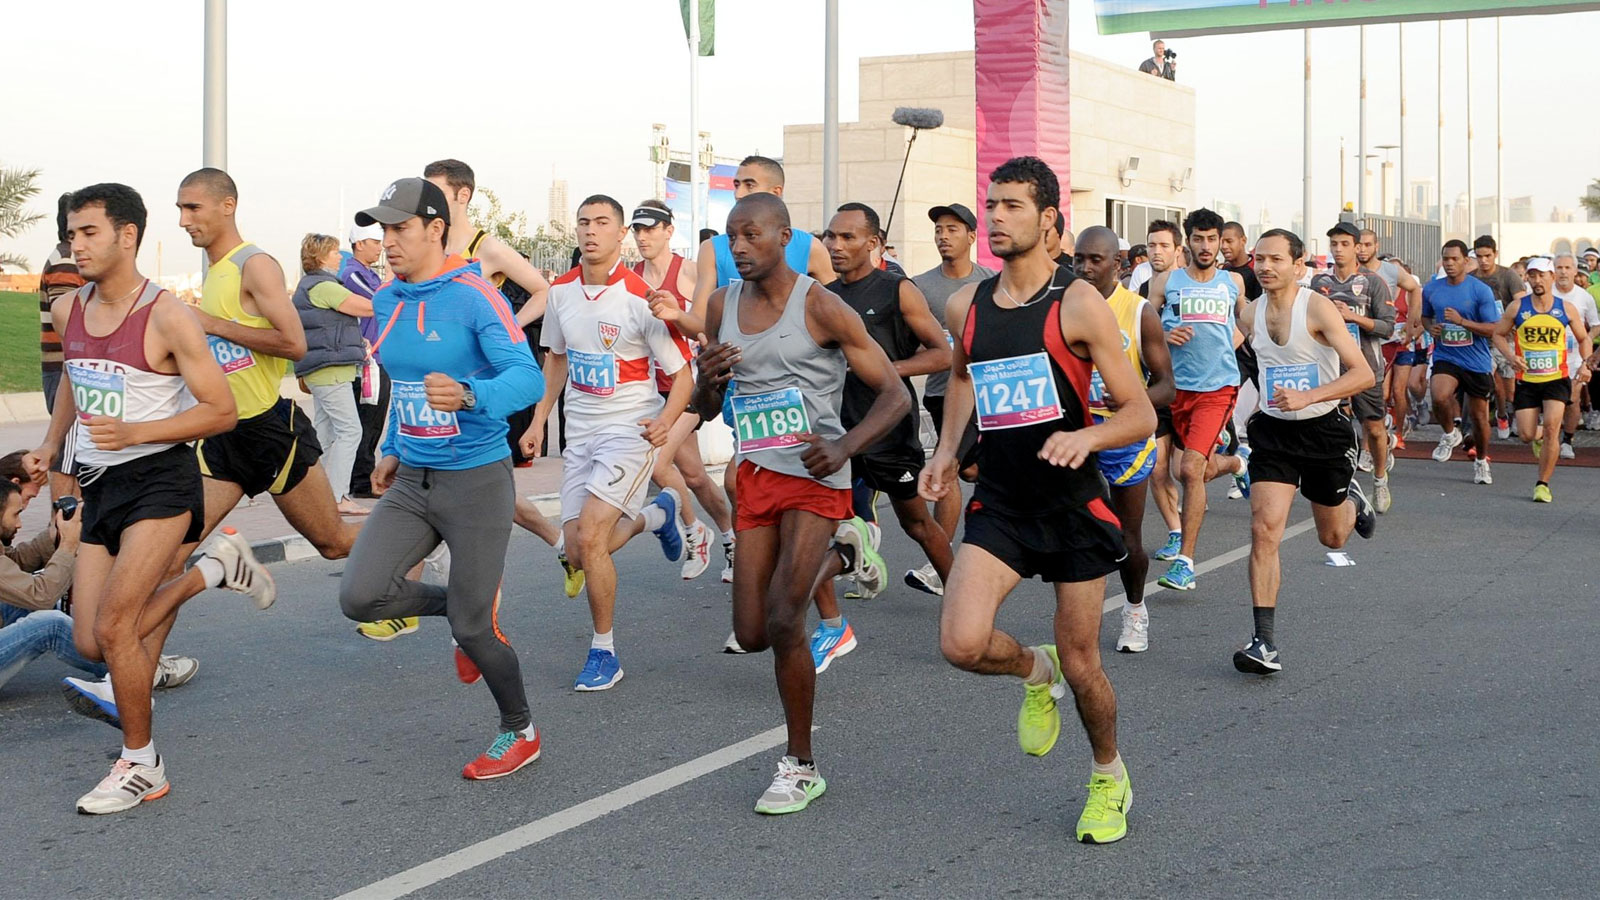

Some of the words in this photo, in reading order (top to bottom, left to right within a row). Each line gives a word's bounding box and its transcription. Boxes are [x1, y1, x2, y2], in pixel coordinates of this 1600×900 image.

[1183, 298, 1227, 316] 1003
[1445, 331, 1467, 342] 412
[1524, 327, 1561, 337] RUN
[1530, 358, 1553, 369] 668
[569, 362, 610, 387] 1141
[75, 384, 121, 417] 020
[979, 376, 1048, 415] 1247
[740, 408, 804, 440] 1189
